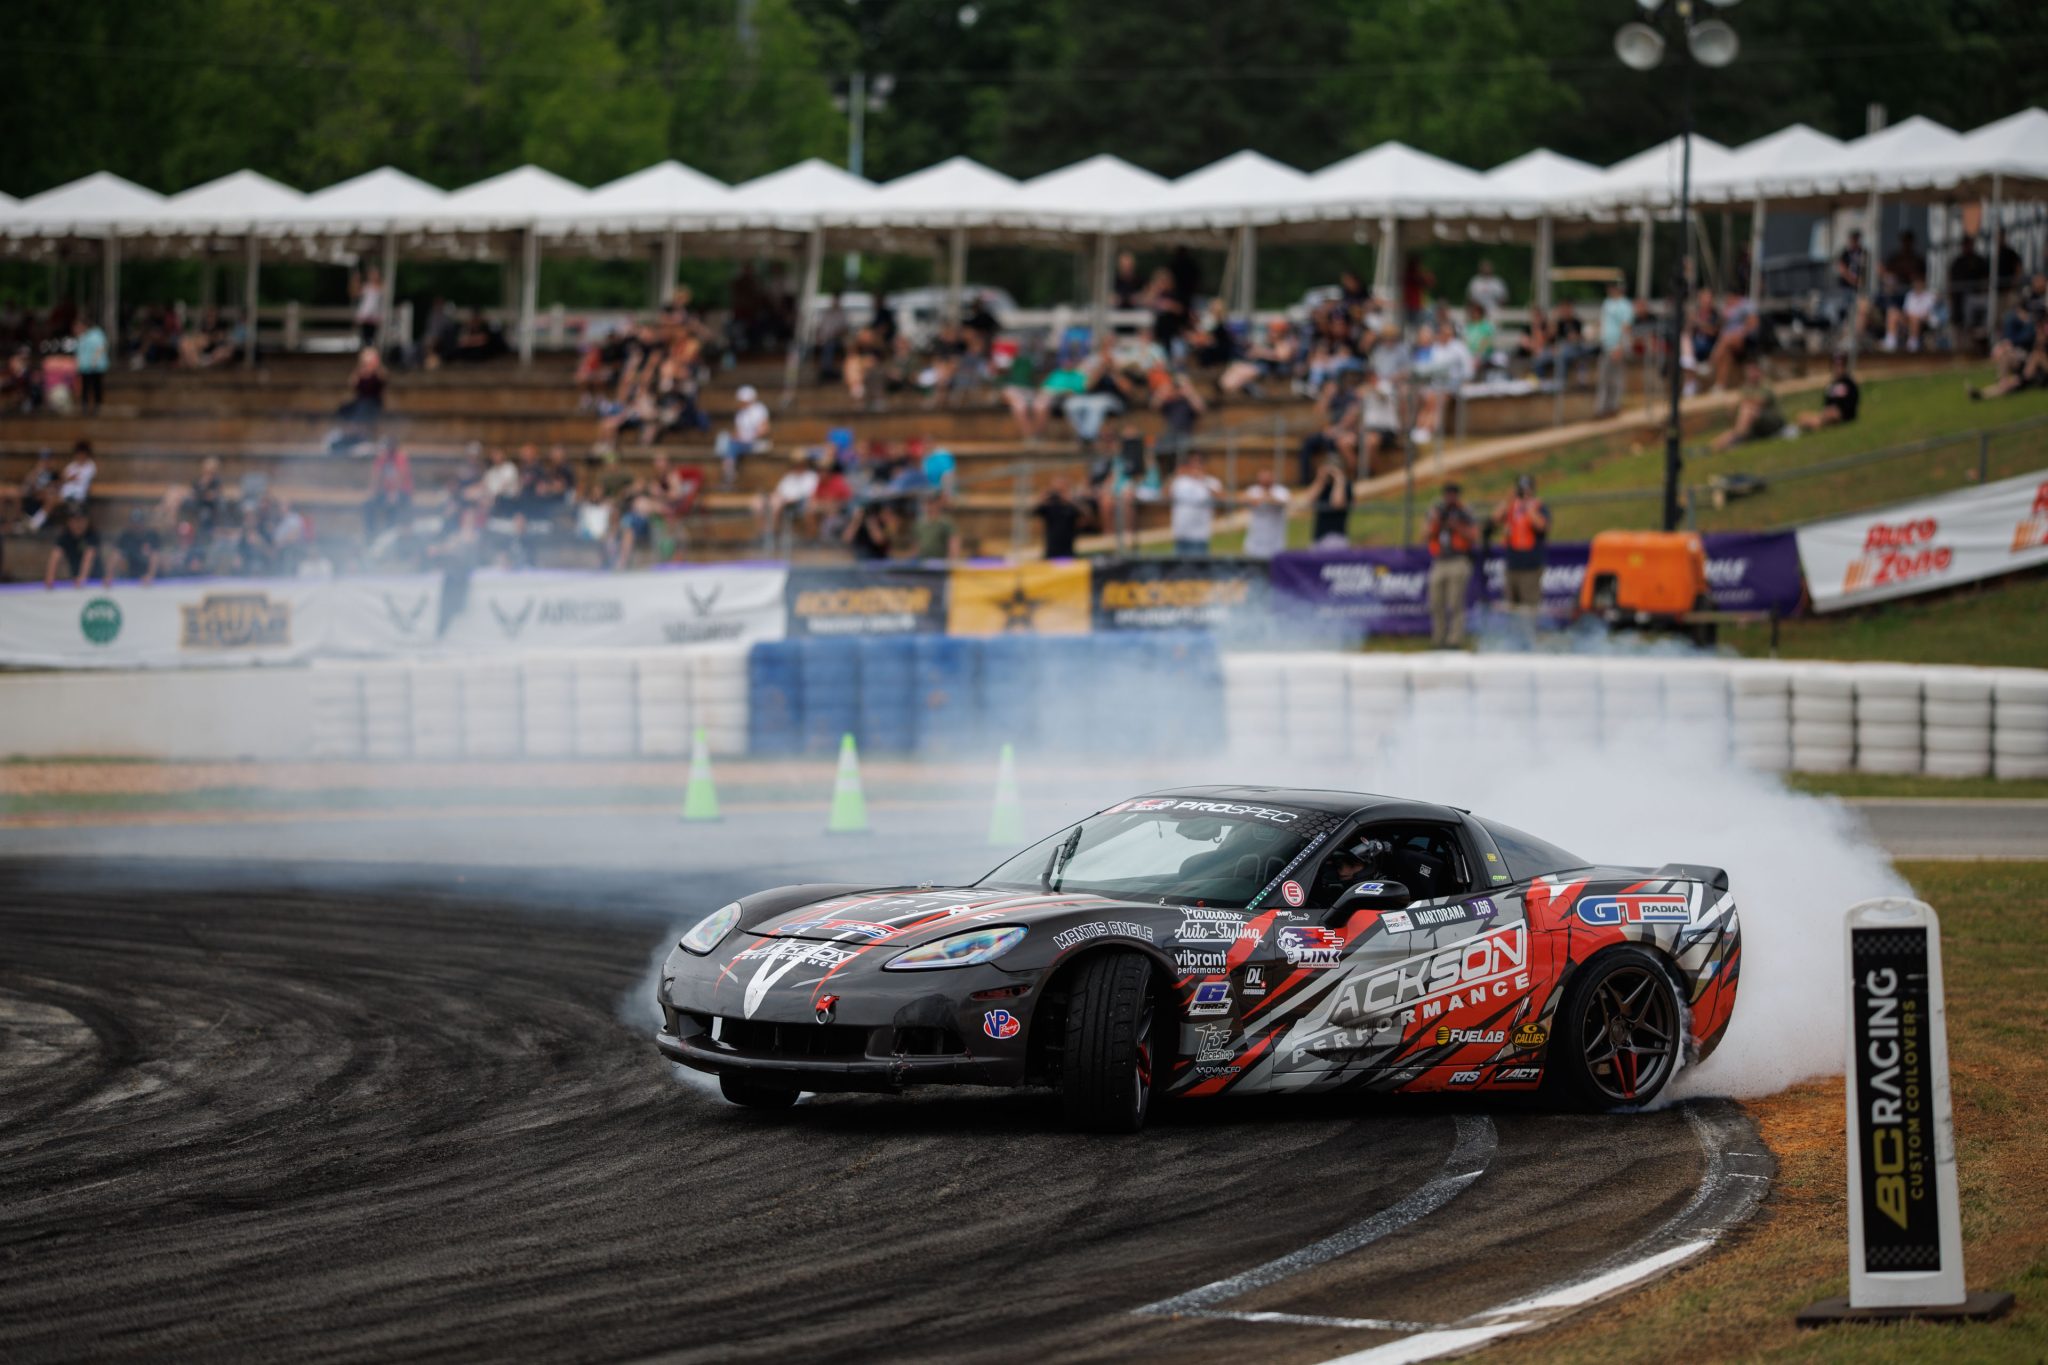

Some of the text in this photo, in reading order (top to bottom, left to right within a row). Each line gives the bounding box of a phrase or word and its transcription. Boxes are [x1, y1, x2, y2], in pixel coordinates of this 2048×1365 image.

[1173, 801, 1298, 823] PROSPEC
[1415, 904, 1466, 925] MARTORANA
[1472, 900, 1491, 916] 166
[1577, 893, 1687, 925] GT RADIAL
[1053, 921, 1153, 949] MANTIS ANGLE
[1175, 920, 1264, 948] Auto-Styling
[1175, 950, 1227, 966] vibrant
[1300, 950, 1340, 962] LINK
[1178, 966, 1226, 975] performance
[984, 1009, 1010, 1038] VP
[1292, 973, 1529, 1064] PERFORMANCE
[1515, 1033, 1545, 1044] CALLIES
[1866, 967, 1903, 1124] RACING
[1450, 1071, 1480, 1082] RTS
[1902, 1000, 1925, 1201] CUSTOM COILOVERS
